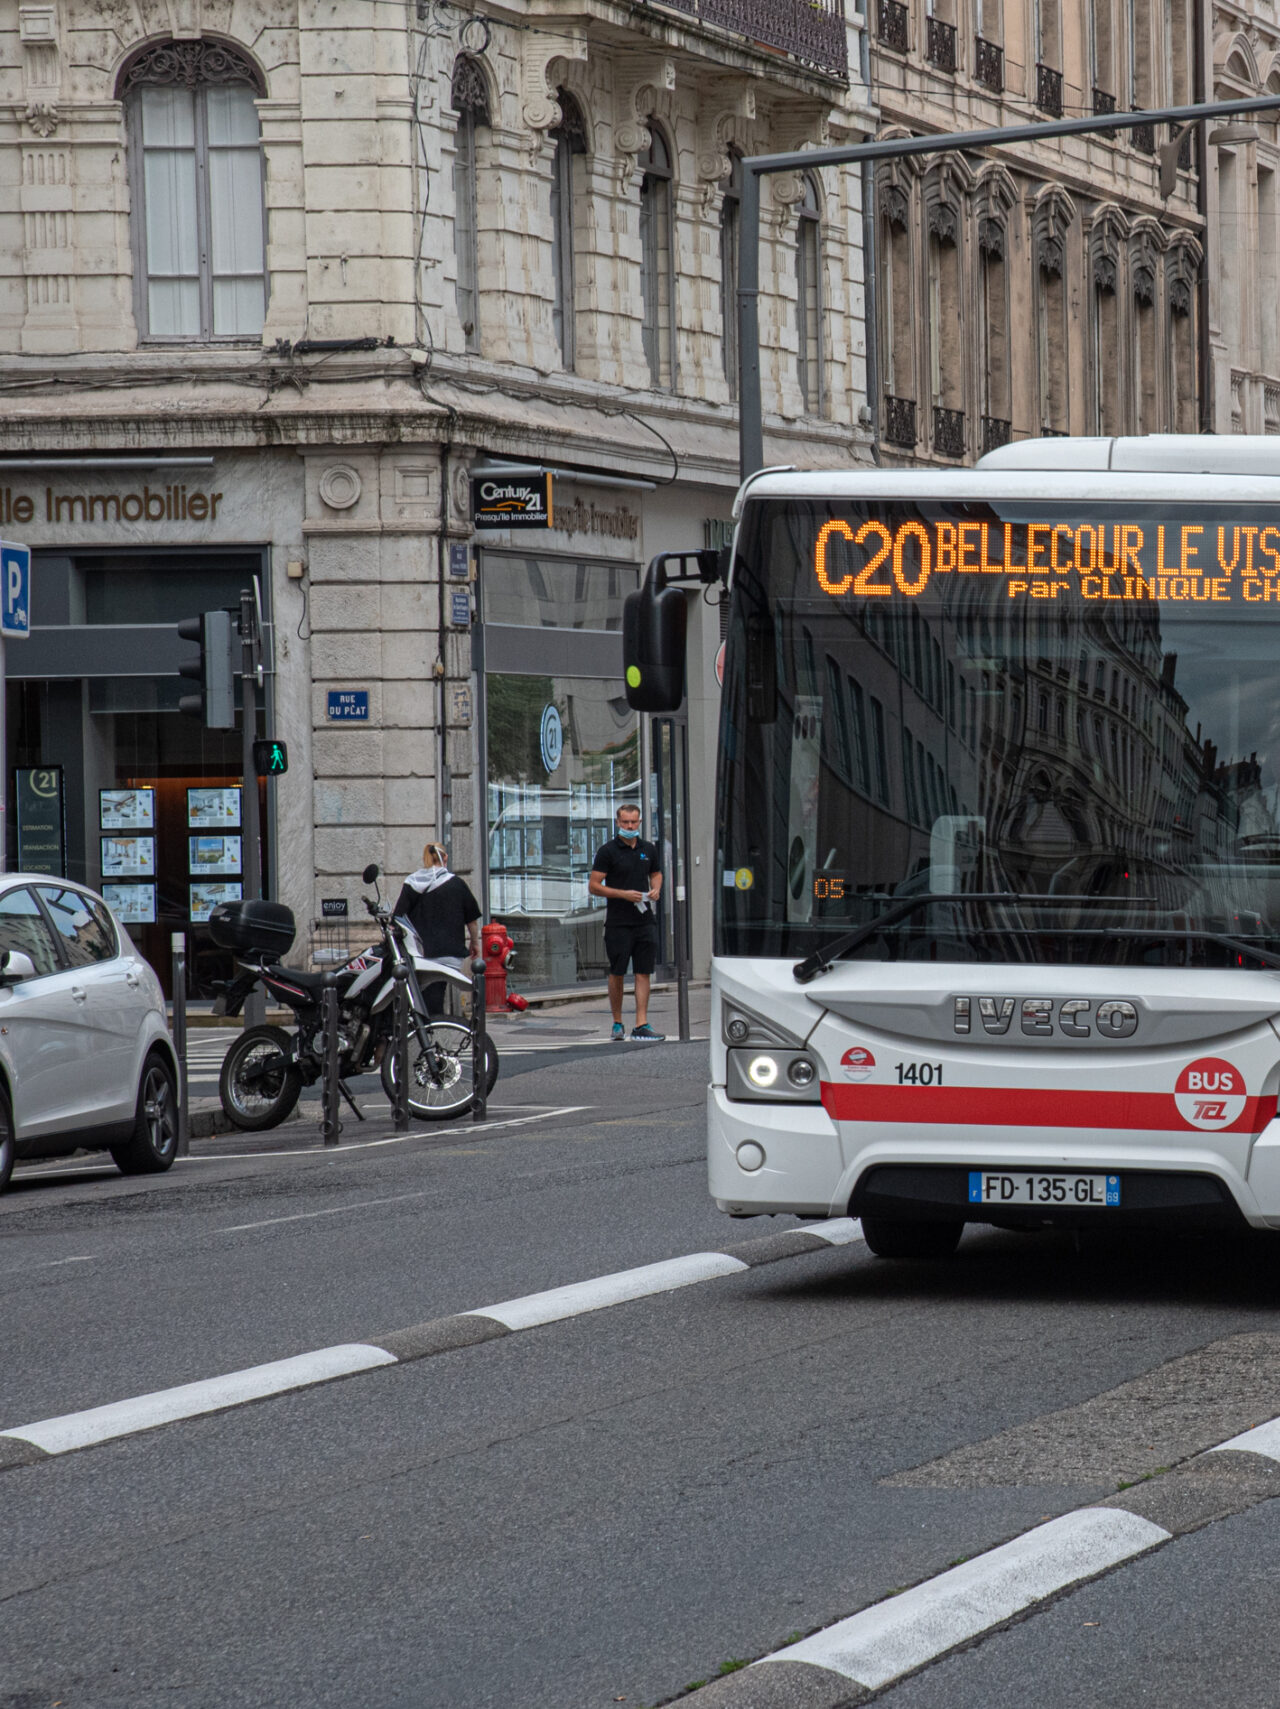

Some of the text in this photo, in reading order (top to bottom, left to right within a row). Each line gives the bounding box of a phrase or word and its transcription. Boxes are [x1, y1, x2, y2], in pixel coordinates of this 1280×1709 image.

[480, 482, 531, 501] Century
[46, 485, 223, 522] Immobilier
[525, 493, 541, 511] 21
[511, 511, 548, 521] Immobilier
[815, 520, 931, 596] C20
[934, 522, 1144, 575] BELLECOUR
[1157, 525, 1204, 576] LE
[8, 560, 21, 614] P
[1081, 576, 1231, 600] CLINIQUE
[340, 695, 355, 703] RUE
[329, 706, 341, 715] DU
[814, 878, 845, 899] 05
[323, 901, 346, 911] enjoy
[953, 997, 1139, 1039] IVECO
[894, 1062, 943, 1086] 1401
[1188, 1071, 1233, 1091] BUS
[1193, 1100, 1228, 1120] TCL
[1106, 1191, 1119, 1203] 69
